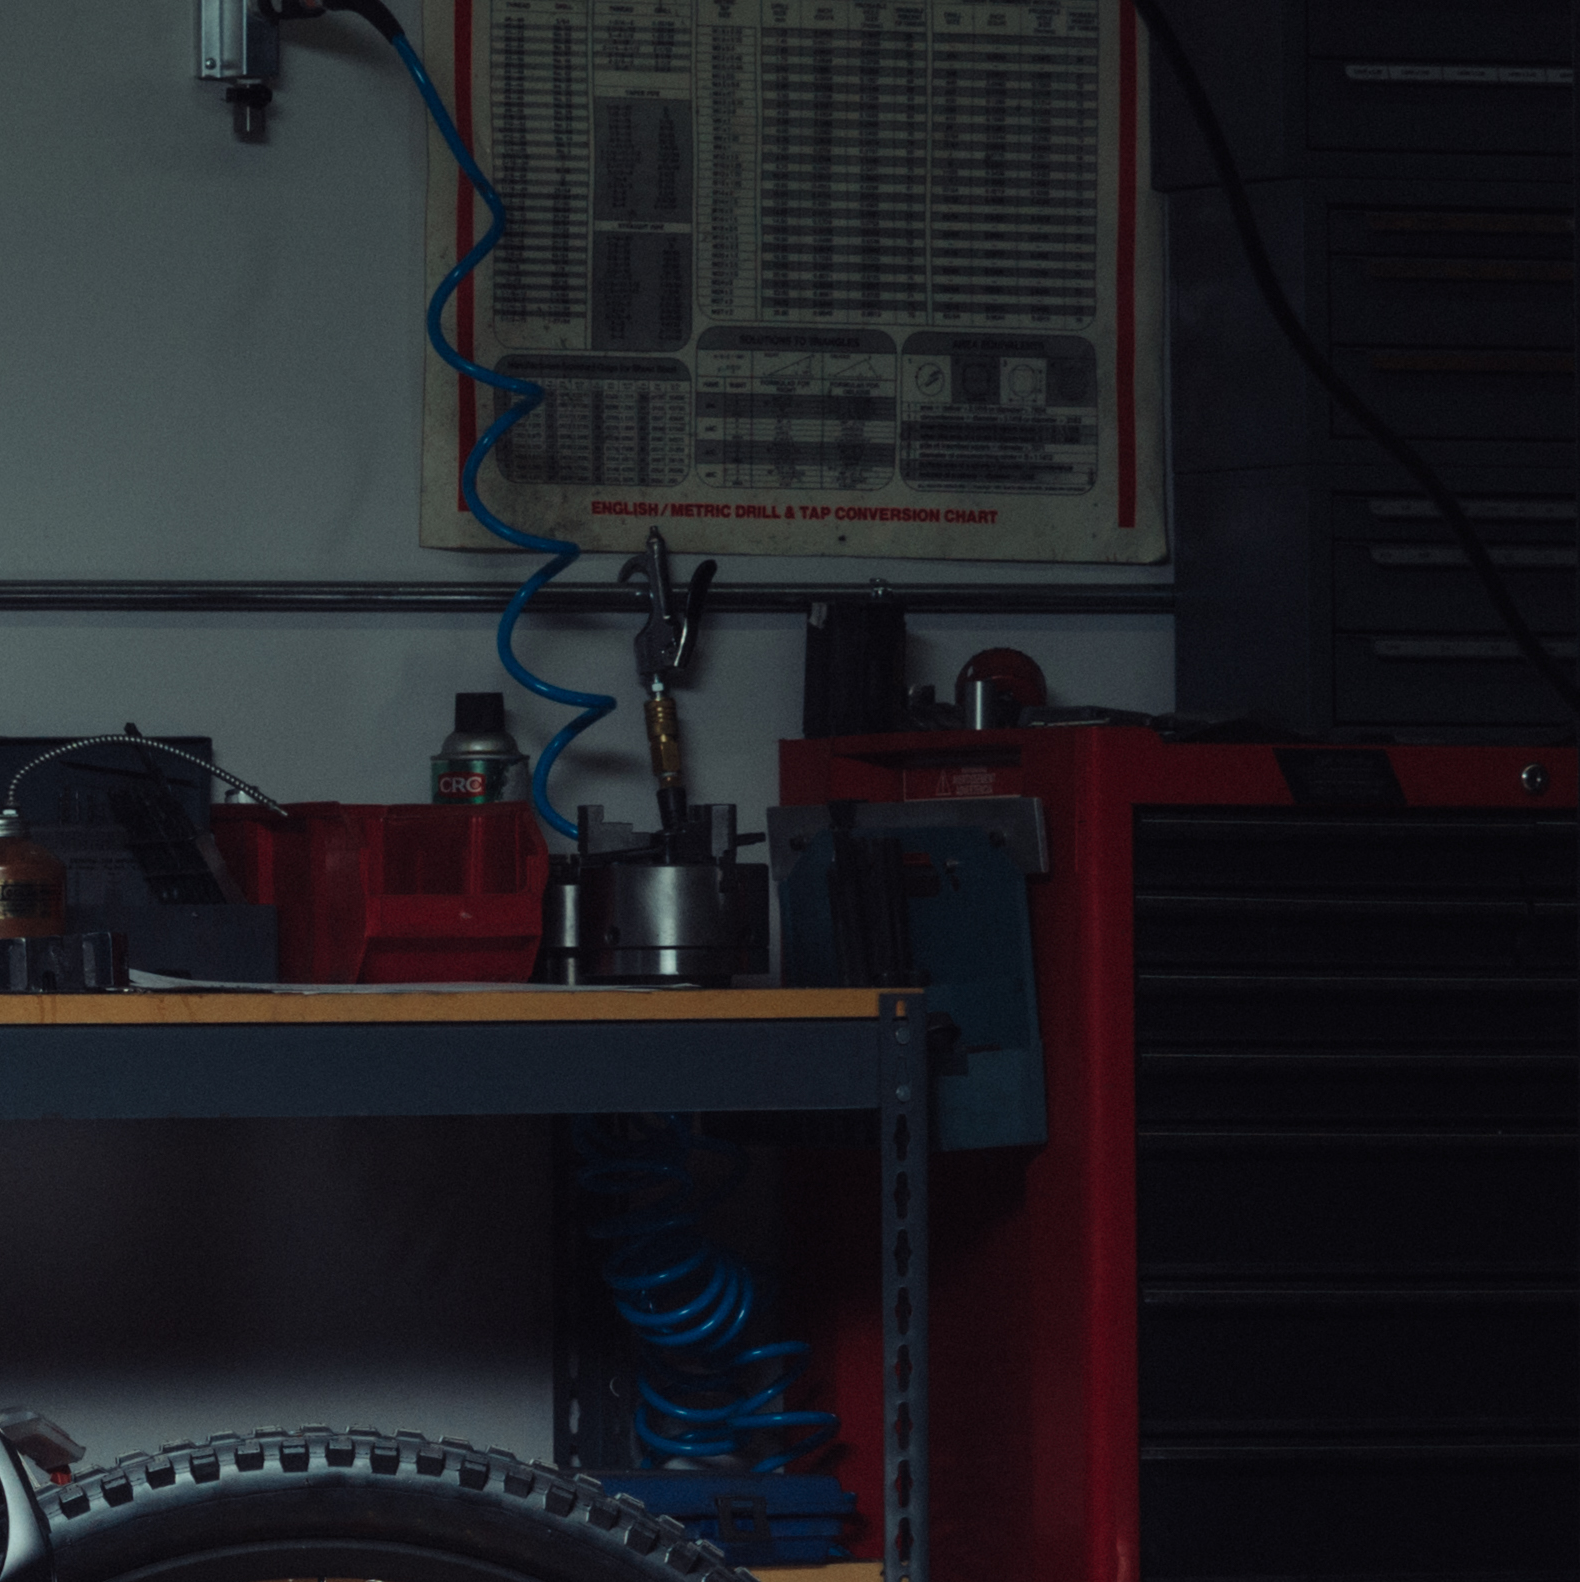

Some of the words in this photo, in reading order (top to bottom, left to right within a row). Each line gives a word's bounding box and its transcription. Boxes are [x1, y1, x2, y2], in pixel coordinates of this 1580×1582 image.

[591, 501, 659, 517] ENGLISH
[671, 503, 732, 519] METRIC
[735, 505, 781, 519] DRILL
[784, 506, 795, 519] &
[800, 506, 832, 520] TAP
[835, 507, 940, 523] CONVERSION
[944, 509, 998, 525] CHART
[439, 776, 482, 793] CRC
